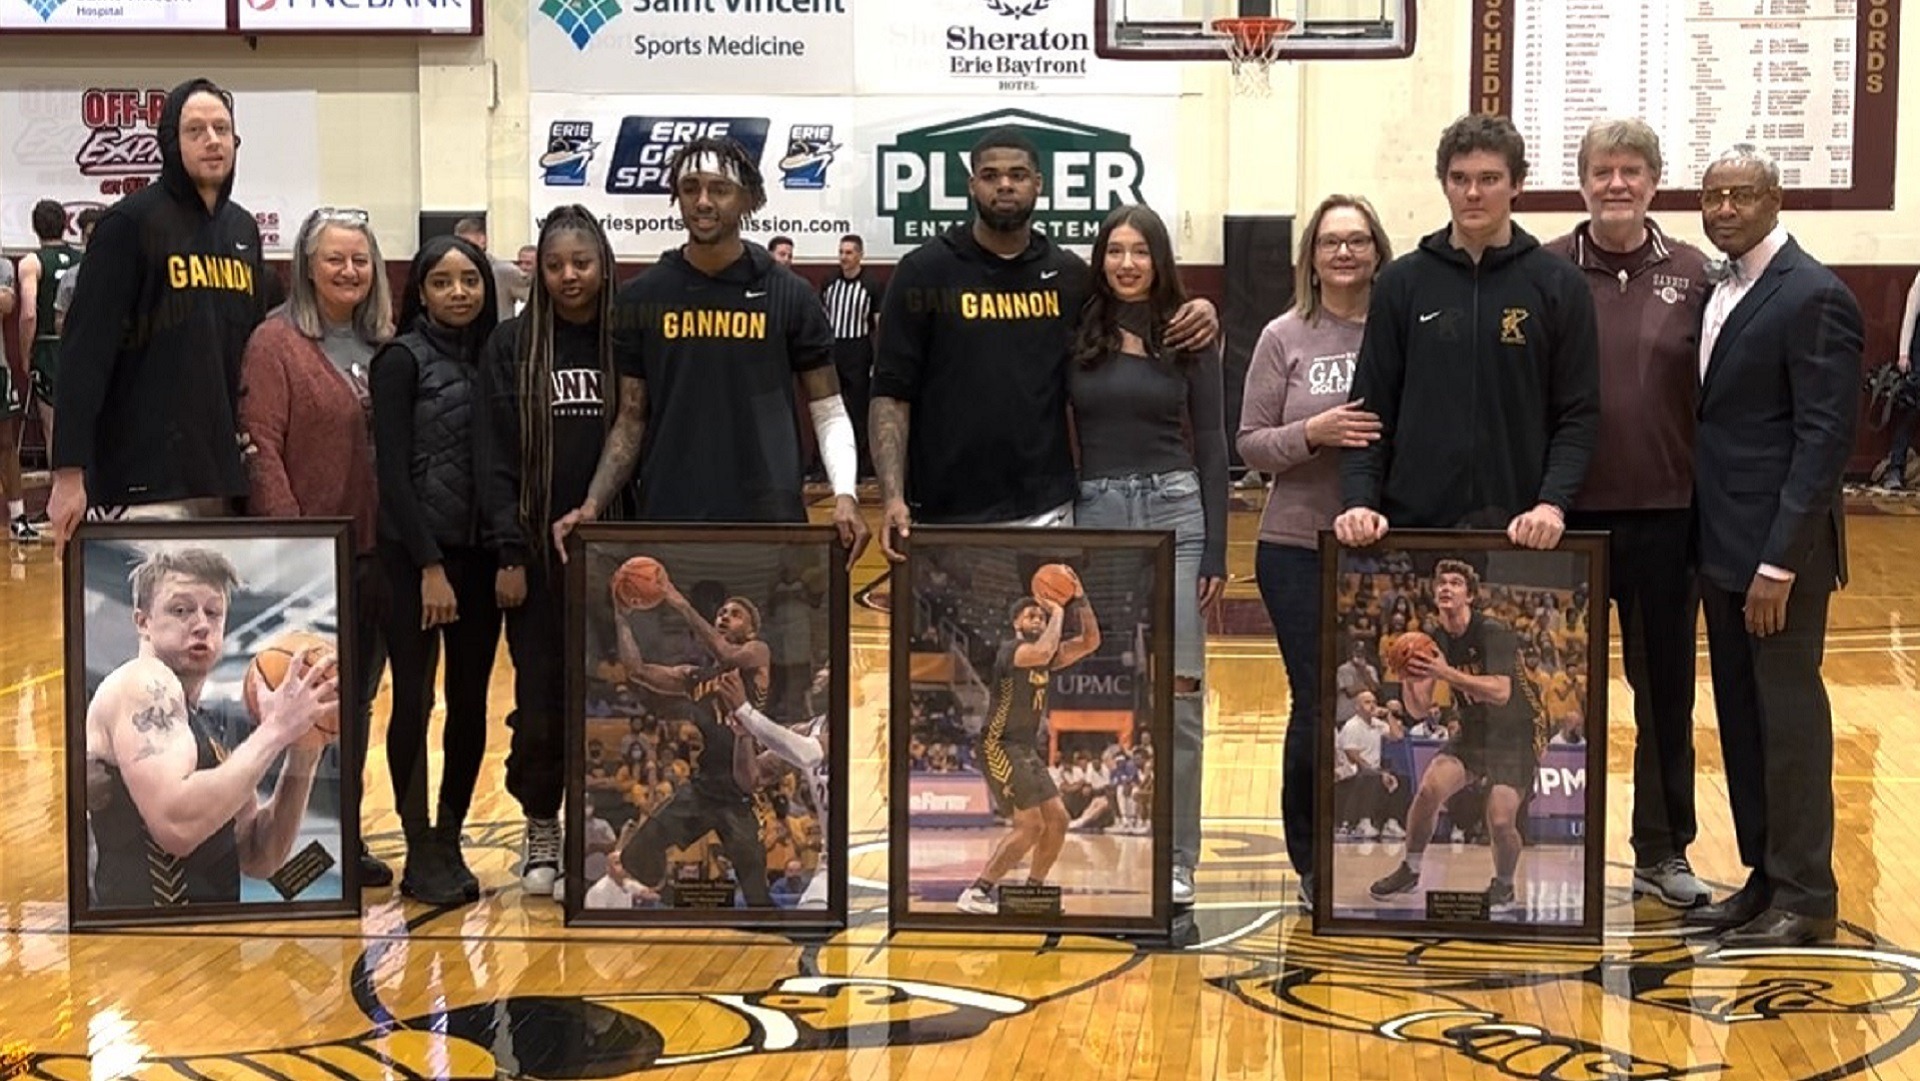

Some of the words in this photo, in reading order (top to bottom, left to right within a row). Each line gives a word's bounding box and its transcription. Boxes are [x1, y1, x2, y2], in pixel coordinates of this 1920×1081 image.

[634, 35, 700, 58] Sports
[708, 35, 805, 56] Medicine
[946, 26, 1089, 50] Sheraton
[950, 56, 992, 74] Erie
[997, 56, 1087, 76] Bayfront
[999, 80, 1039, 91] HOTEL
[553, 124, 590, 137] ERIE
[650, 122, 730, 142] ERIE
[792, 126, 831, 140] ERIE
[884, 152, 1138, 210] PLER
[1032, 221, 1100, 237] STEM
[168, 254, 254, 296] GANNON
[961, 290, 1060, 319] GANNON
[663, 309, 767, 339] GANNON
[1056, 675, 1132, 695] UPMC
[1533, 767, 1586, 796] PM
